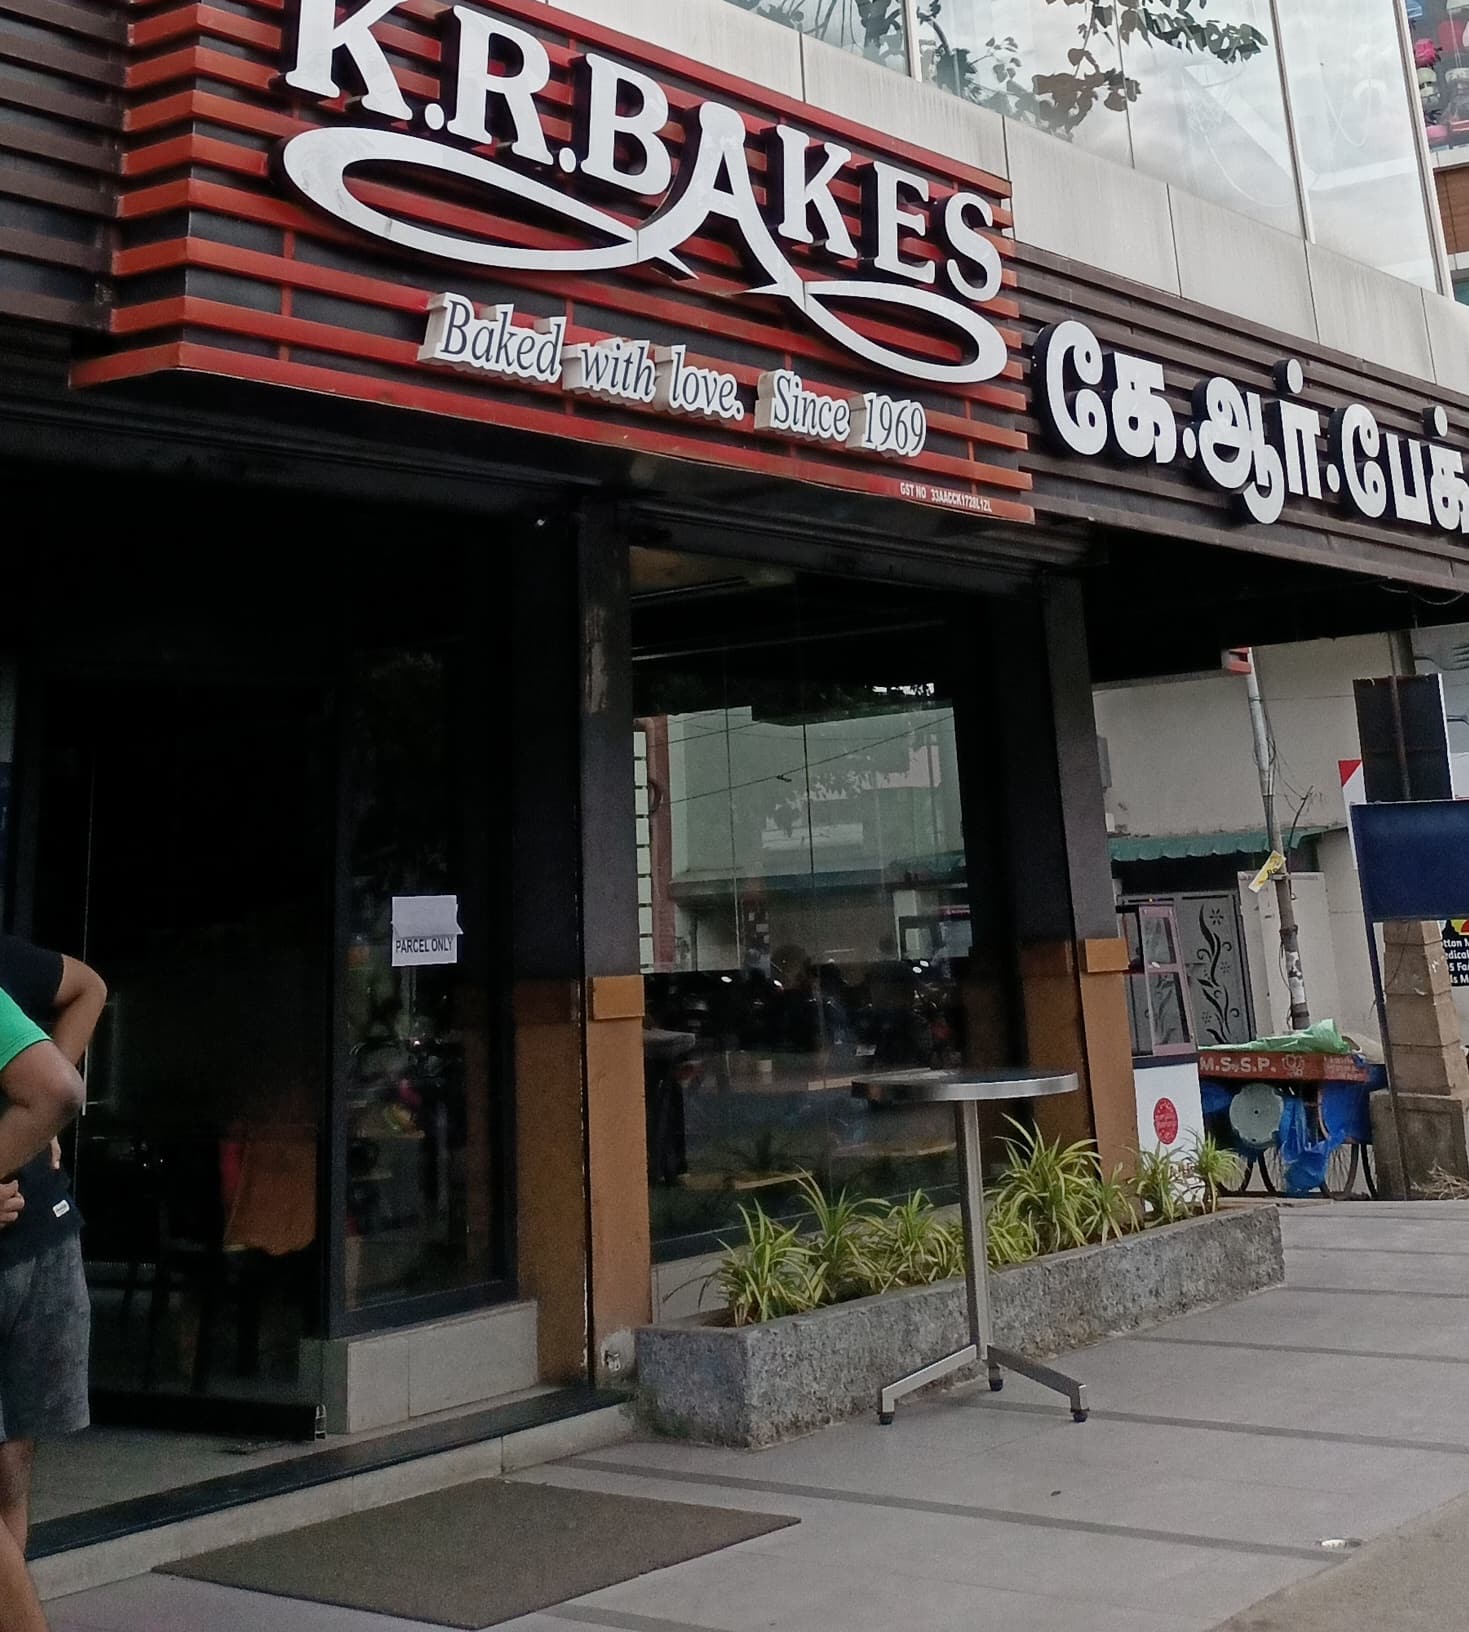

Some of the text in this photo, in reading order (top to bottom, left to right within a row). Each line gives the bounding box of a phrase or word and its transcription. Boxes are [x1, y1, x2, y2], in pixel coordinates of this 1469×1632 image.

[439, 298, 924, 452] Baked with love. Since 1969
[900, 482, 914, 497] GST
[915, 485, 927, 499] NO
[395, 935, 454, 954] PARCEL ONLY
